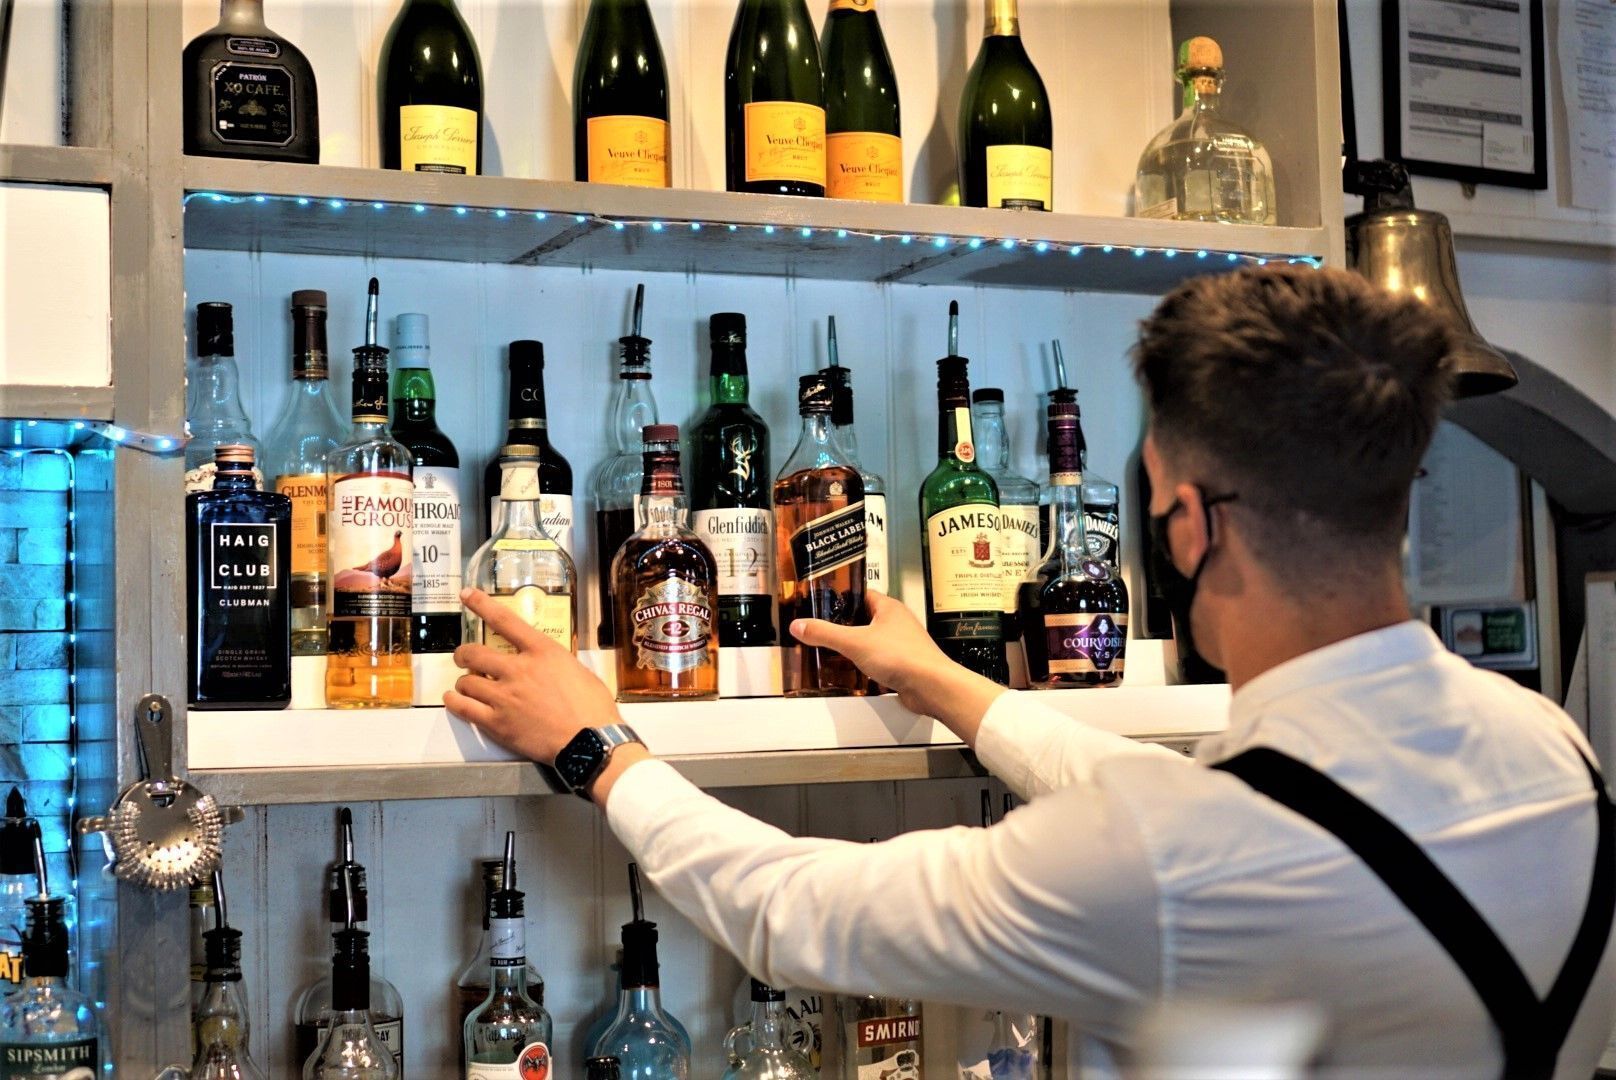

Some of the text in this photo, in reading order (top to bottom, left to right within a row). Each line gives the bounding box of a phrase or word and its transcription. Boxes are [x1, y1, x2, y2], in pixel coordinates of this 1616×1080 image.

[224, 82, 242, 94] XO
[404, 126, 441, 143] Joseph
[766, 134, 794, 145] Veuve
[608, 148, 635, 158] Veuve
[840, 164, 866, 173] Veuve
[342, 496, 352, 526] THE
[354, 512, 412, 528] GROUS
[542, 512, 571, 526] adian
[708, 516, 768, 534] Glenfiddich
[867, 512, 883, 531] AM
[938, 512, 1001, 537] JAMESO
[220, 534, 269, 546] HAIG
[806, 521, 866, 552] BLACK LABEL
[422, 544, 438, 563] 10
[218, 564, 270, 576] CLUB
[726, 547, 757, 578] 12
[868, 569, 880, 580] ON
[423, 579, 440, 588] 1815
[636, 604, 710, 622] CHIVAS REGAL
[670, 622, 682, 634] 12
[644, 641, 668, 650] BLENDED
[690, 640, 706, 650] WHISKY
[7, 1046, 90, 1062] SIPSMITH
